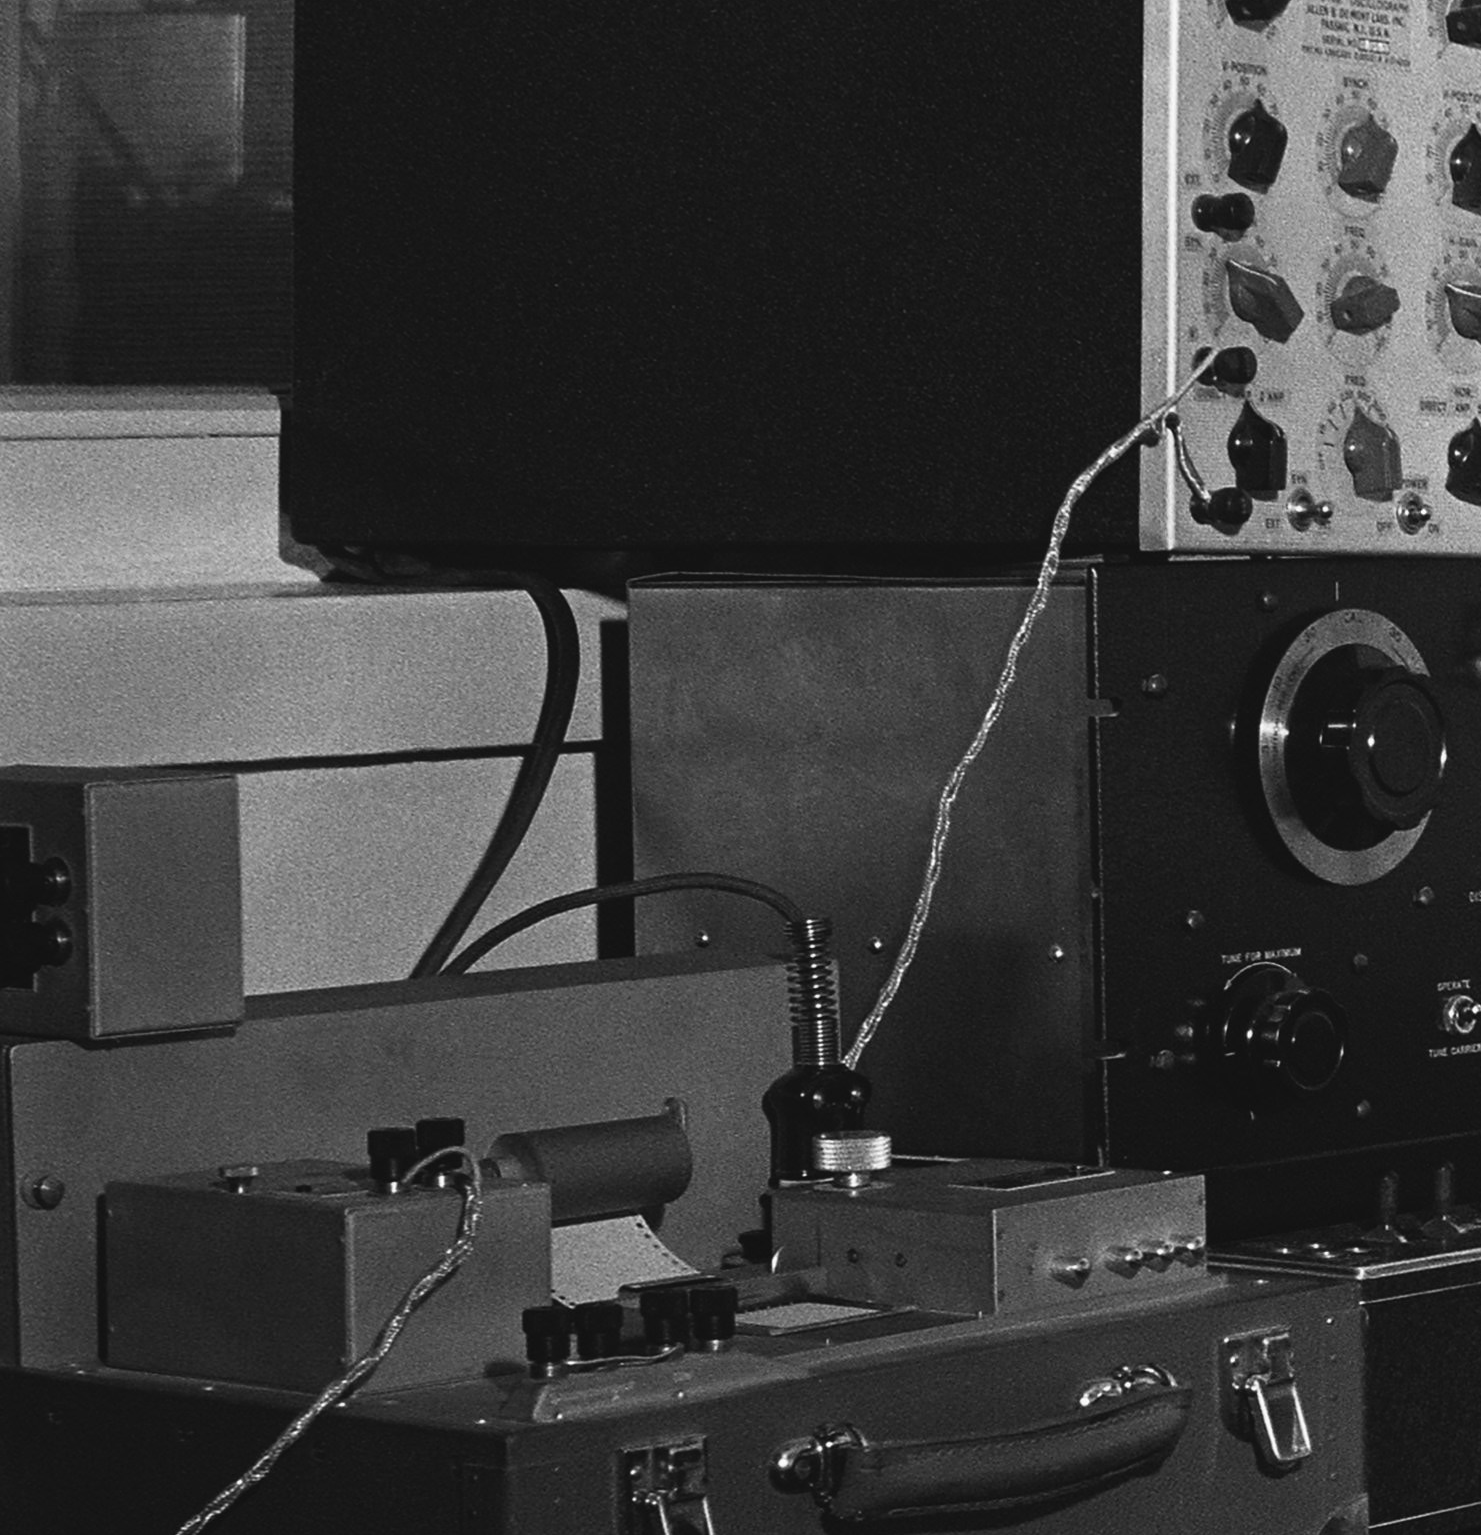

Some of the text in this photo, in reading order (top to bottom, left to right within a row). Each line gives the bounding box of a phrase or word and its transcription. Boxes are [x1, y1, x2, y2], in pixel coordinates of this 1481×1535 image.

[1221, 947, 1302, 964] TUNE FOR MAXIMUM
[1437, 979, 1470, 992] OPERATE
[1450, 1043, 1481, 1055] CARRIER
